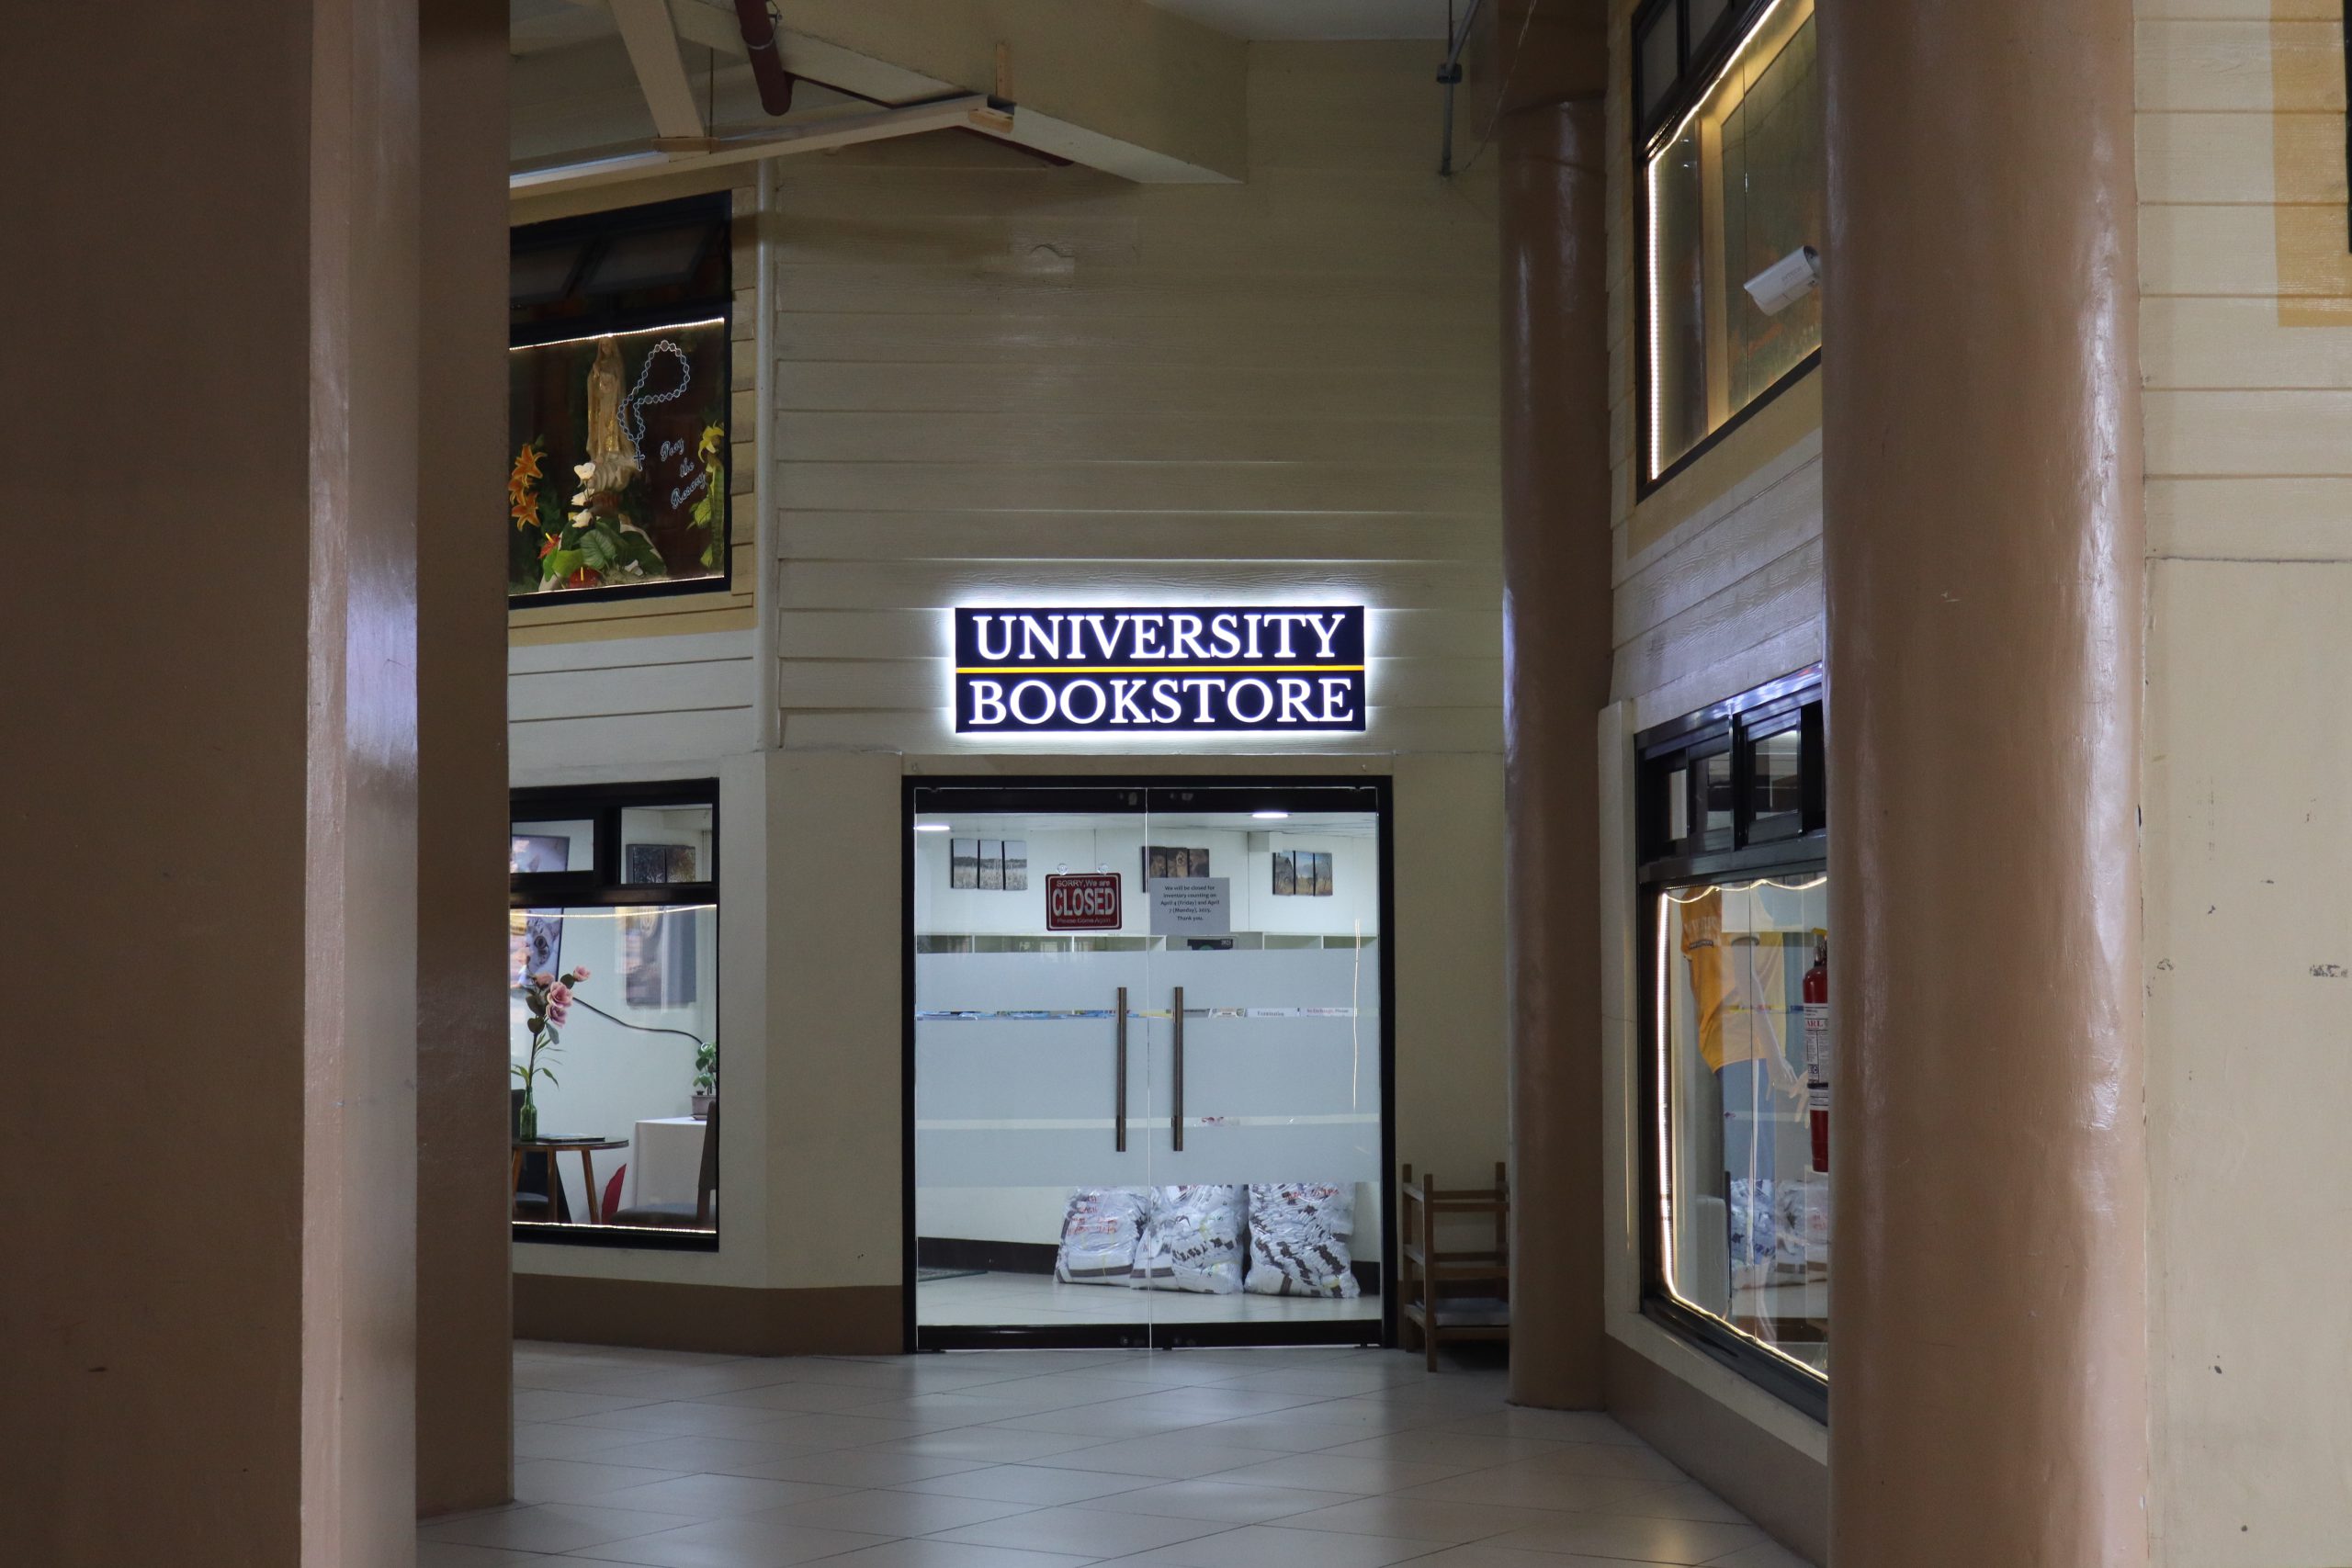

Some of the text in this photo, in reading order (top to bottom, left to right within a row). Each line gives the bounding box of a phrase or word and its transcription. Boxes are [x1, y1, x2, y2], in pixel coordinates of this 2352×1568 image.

[660, 437, 684, 461] Pray
[680, 457, 695, 478] the
[671, 472, 707, 509] Rosary
[972, 614, 1346, 660] UNIVERSITY
[968, 678, 1353, 725] BOOKSTORE
[1052, 887, 1115, 917] CLOSED
